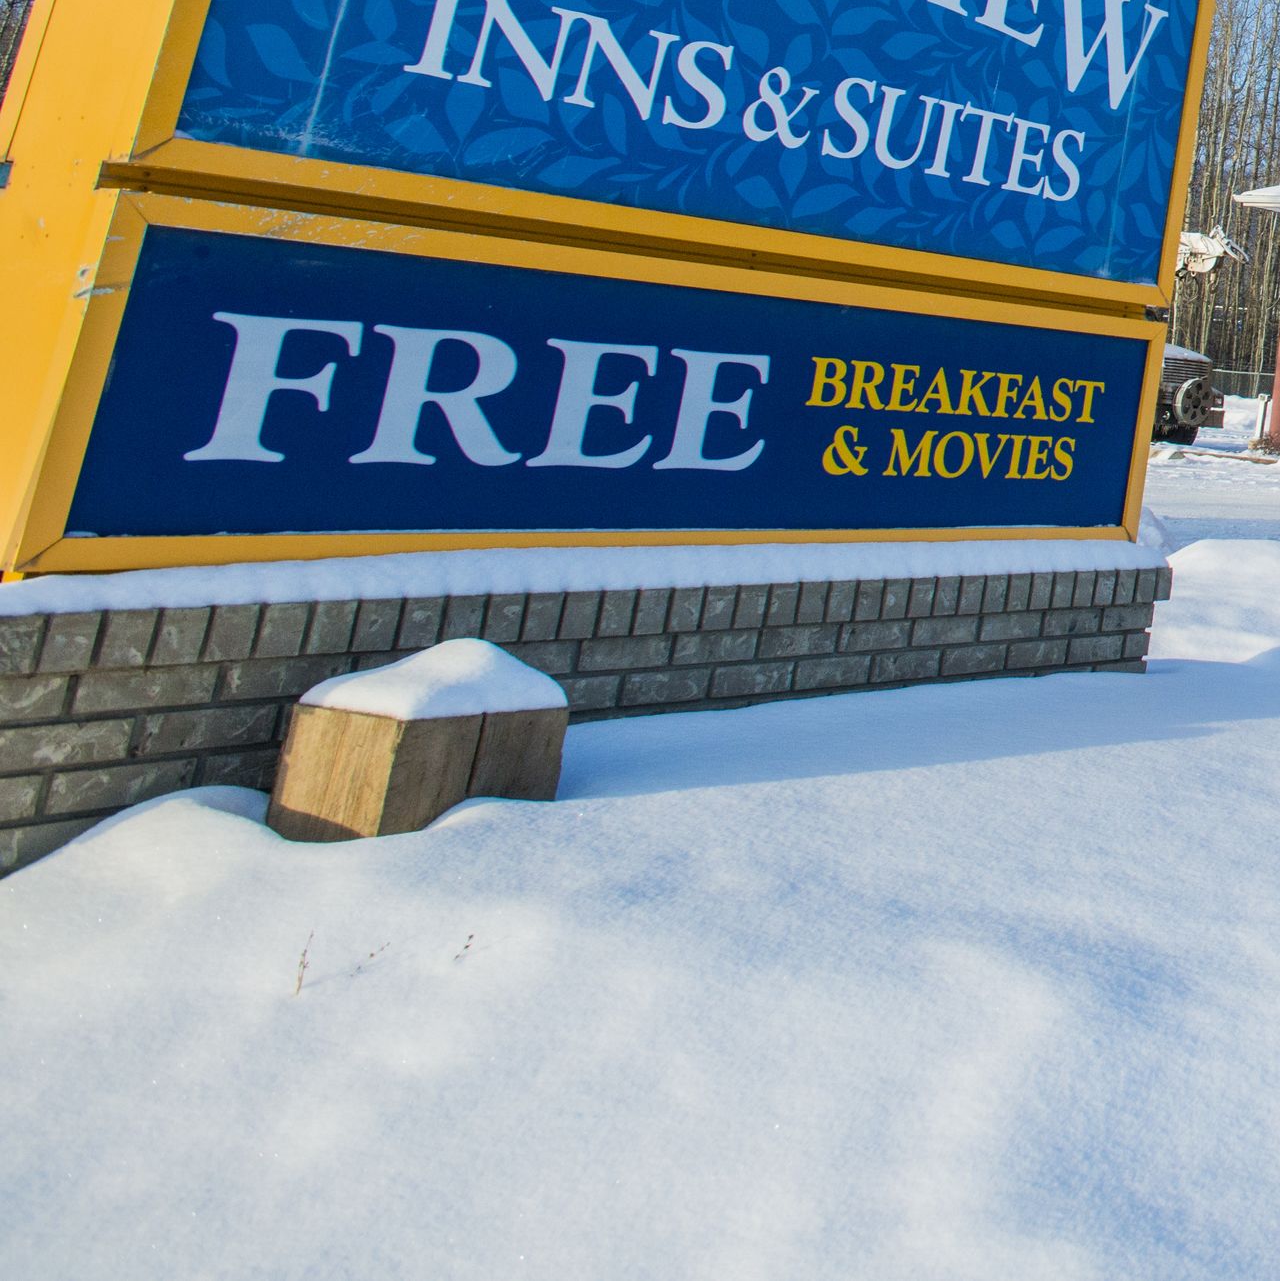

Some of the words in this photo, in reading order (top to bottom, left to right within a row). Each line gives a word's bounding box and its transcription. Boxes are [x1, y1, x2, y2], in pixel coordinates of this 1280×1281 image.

[743, 67, 817, 148] &
[822, 78, 1086, 201] SUITES
[184, 312, 771, 469] FREE
[806, 357, 1105, 423] BREAKFAST
[823, 426, 867, 476] &
[883, 429, 1076, 481] MOVIES
